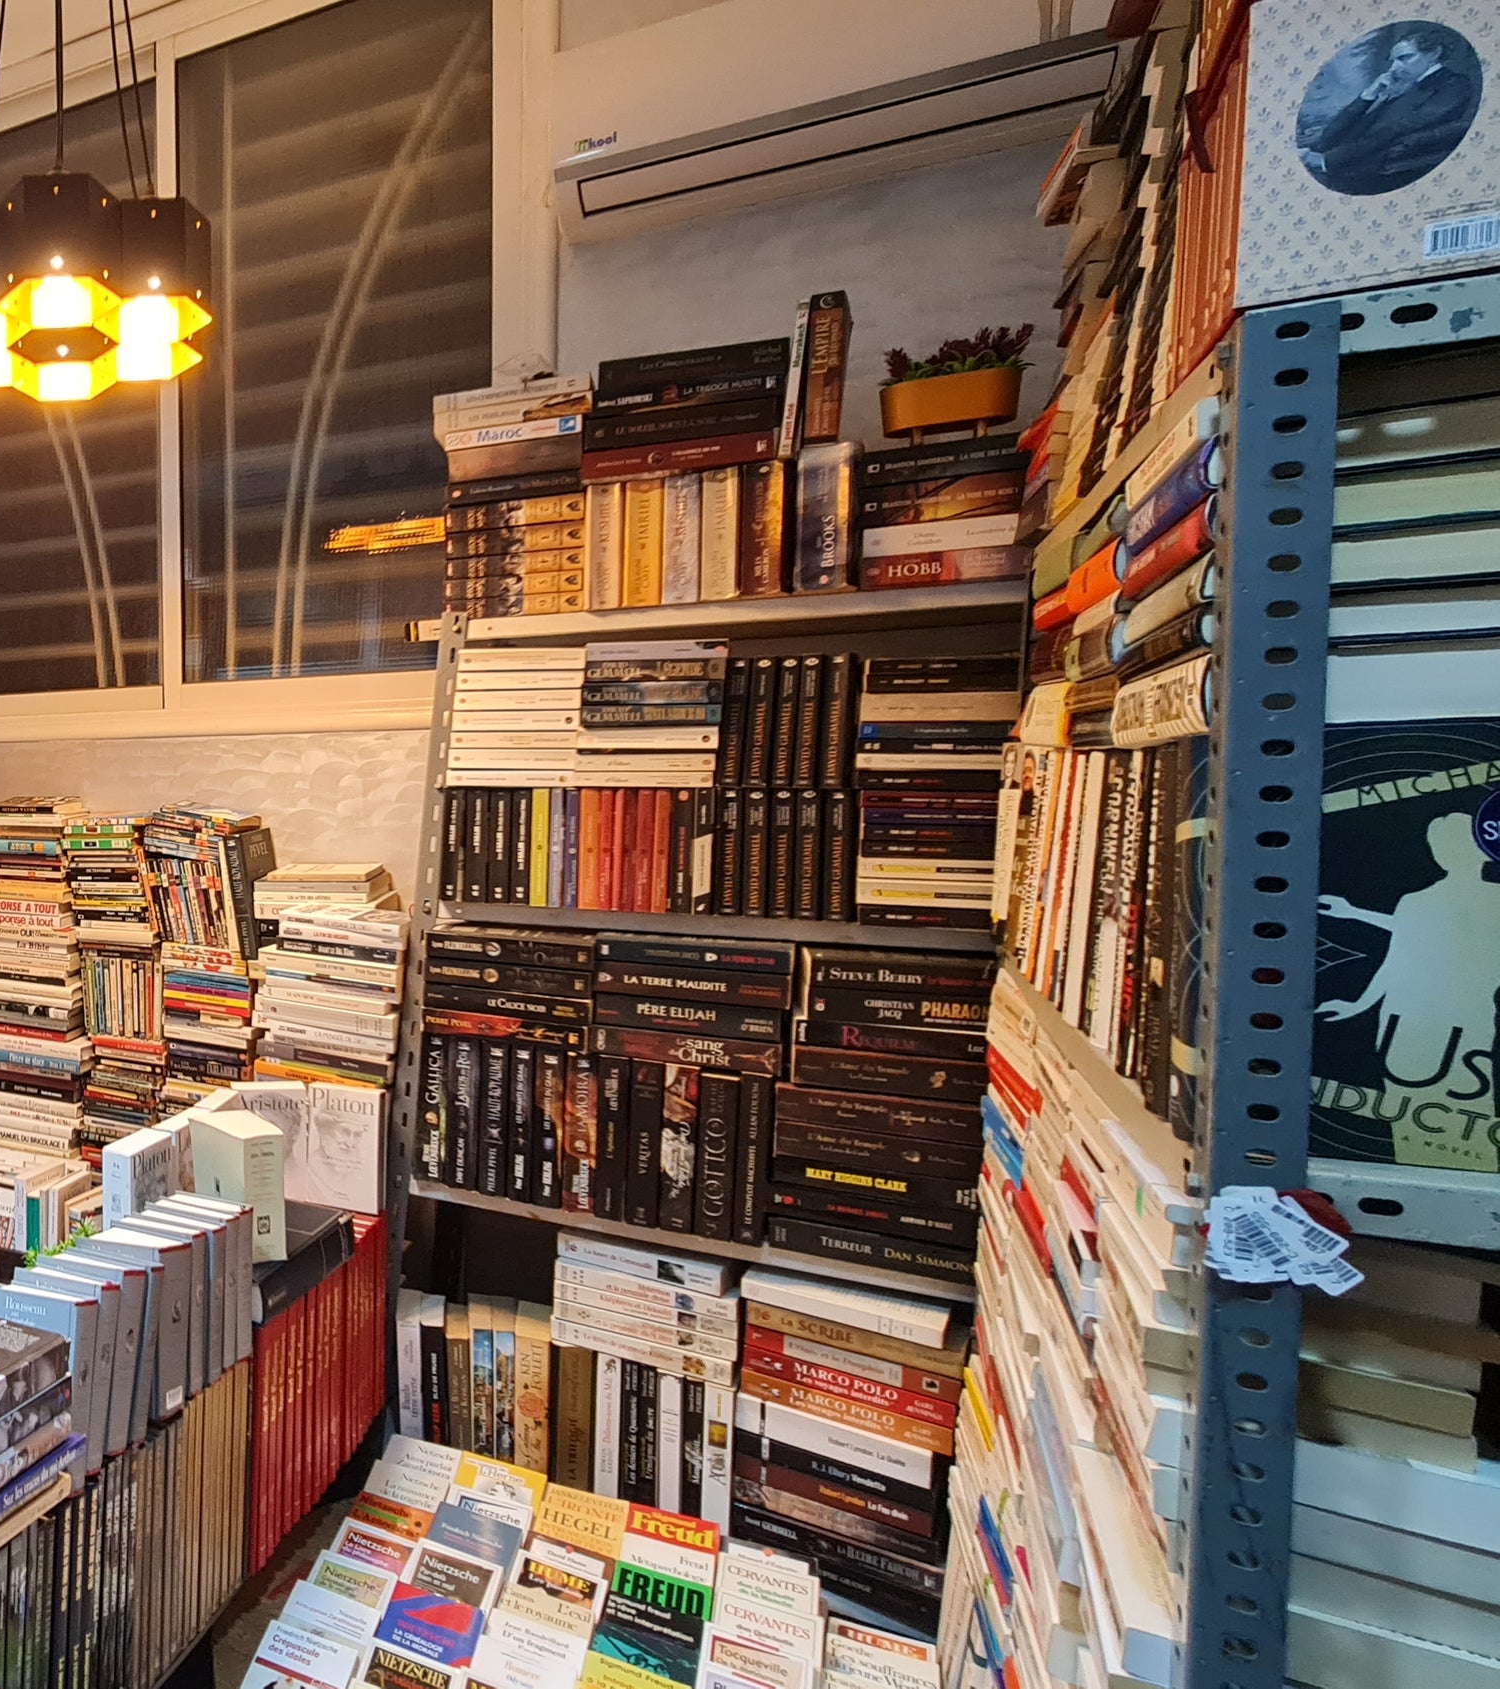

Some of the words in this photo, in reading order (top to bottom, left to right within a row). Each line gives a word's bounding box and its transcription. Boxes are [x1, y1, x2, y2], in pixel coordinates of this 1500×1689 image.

[811, 315, 832, 375] L'EMPIRE
[683, 386, 693, 395] LA
[476, 426, 524, 443] Maroc
[821, 514, 836, 569] BROOKS
[888, 561, 942, 578] HOBB
[777, 746, 789, 778] DAVID
[750, 833, 761, 877] GEMMELL
[749, 877, 759, 908] DAVID
[34, 904, 57, 914] TOUT
[36, 917, 54, 927] tout
[16, 940, 26, 949] La
[28, 941, 50, 950] Bible
[623, 975, 638, 984] LA
[642, 976, 674, 987] TERRE
[676, 979, 727, 992] MAUDITE
[829, 967, 876, 982] STEVE
[878, 968, 924, 985] BERRY
[636, 1003, 667, 1017] PÈRE
[670, 1006, 716, 1021] ELIJAH
[864, 998, 915, 1011] CHRISTIAN
[878, 1008, 903, 1020] JACQ
[678, 1048, 731, 1066] Christ
[685, 1039, 724, 1056] sang
[425, 1050, 443, 1104] GALLICA
[240, 1093, 307, 1111] Aristote
[311, 1087, 375, 1116] Platon
[0, 1131, 21, 1142] MANUEL
[30, 1136, 60, 1149] BRICOLAGE
[1424, 1141, 1482, 1160] NOVEL
[132, 1147, 171, 1179] Platon
[638, 1131, 650, 1176] VERITAS
[805, 1167, 833, 1180] MARY
[875, 1174, 907, 1192] CLARK
[820, 1235, 872, 1255] TERREUR
[884, 1247, 912, 1262] DAN
[5, 1296, 46, 1315] Rousseau
[781, 1316, 793, 1326] LA
[798, 1319, 854, 1344] SCRIBE
[794, 1362, 850, 1386] MARCO
[853, 1379, 898, 1401] POLO
[796, 1373, 812, 1382] Les
[813, 1377, 849, 1395] voyages
[850, 1390, 890, 1406] interdits
[789, 1397, 807, 1406] Les
[809, 1401, 842, 1419] voyages
[842, 1413, 882, 1430] interdits
[790, 1388, 847, 1412] MARCO
[850, 1403, 895, 1425] POLO
[417, 1445, 456, 1462] Nietzsche
[402, 1472, 439, 1491] Nietzsche
[462, 1502, 521, 1527] Nietzsche
[542, 1507, 617, 1541] HEGEL
[631, 1510, 714, 1549] Freud
[348, 1532, 401, 1559] Nietzsche
[423, 1554, 480, 1584] Nietzsche
[680, 1556, 709, 1571] Freud
[324, 1566, 376, 1592] Nietzsche
[529, 1560, 591, 1593] HUME
[727, 1564, 809, 1596] CERVANTES
[617, 1568, 705, 1617] FREUD
[527, 1606, 578, 1631] royaume
[557, 1603, 592, 1624] L'exil
[724, 1603, 811, 1640] CERVANTES
[272, 1634, 320, 1658] Crépuscule
[392, 1634, 402, 1643] DE
[830, 1638, 873, 1658] Goethe
[268, 1644, 283, 1655] des
[285, 1648, 312, 1667] idoles
[375, 1649, 449, 1687] NIETZSCHE
[719, 1645, 789, 1677] Tocqueville
